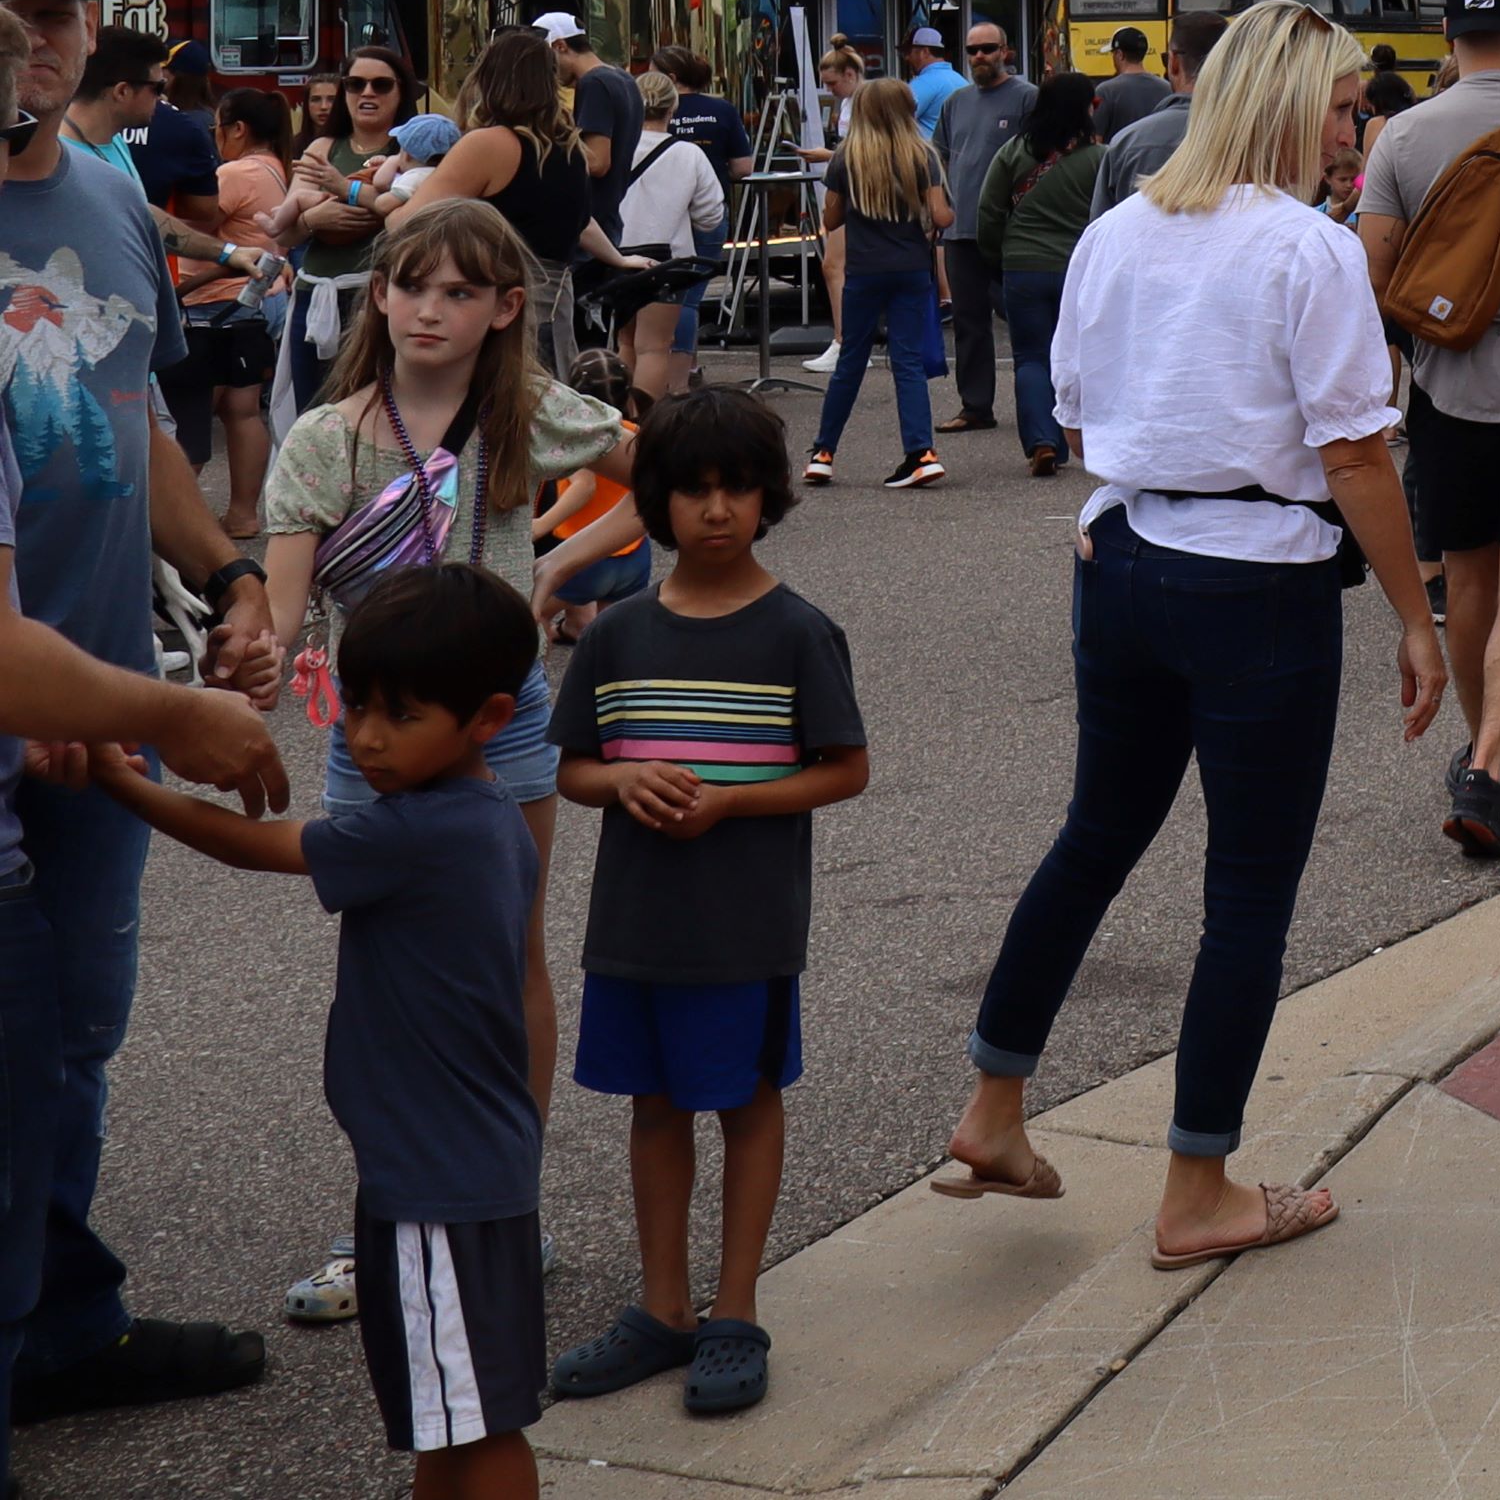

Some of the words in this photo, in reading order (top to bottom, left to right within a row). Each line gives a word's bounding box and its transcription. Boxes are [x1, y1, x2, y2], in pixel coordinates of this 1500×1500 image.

[682, 115, 718, 124] Students
[676, 126, 694, 134] First
[122, 126, 149, 146] ON
